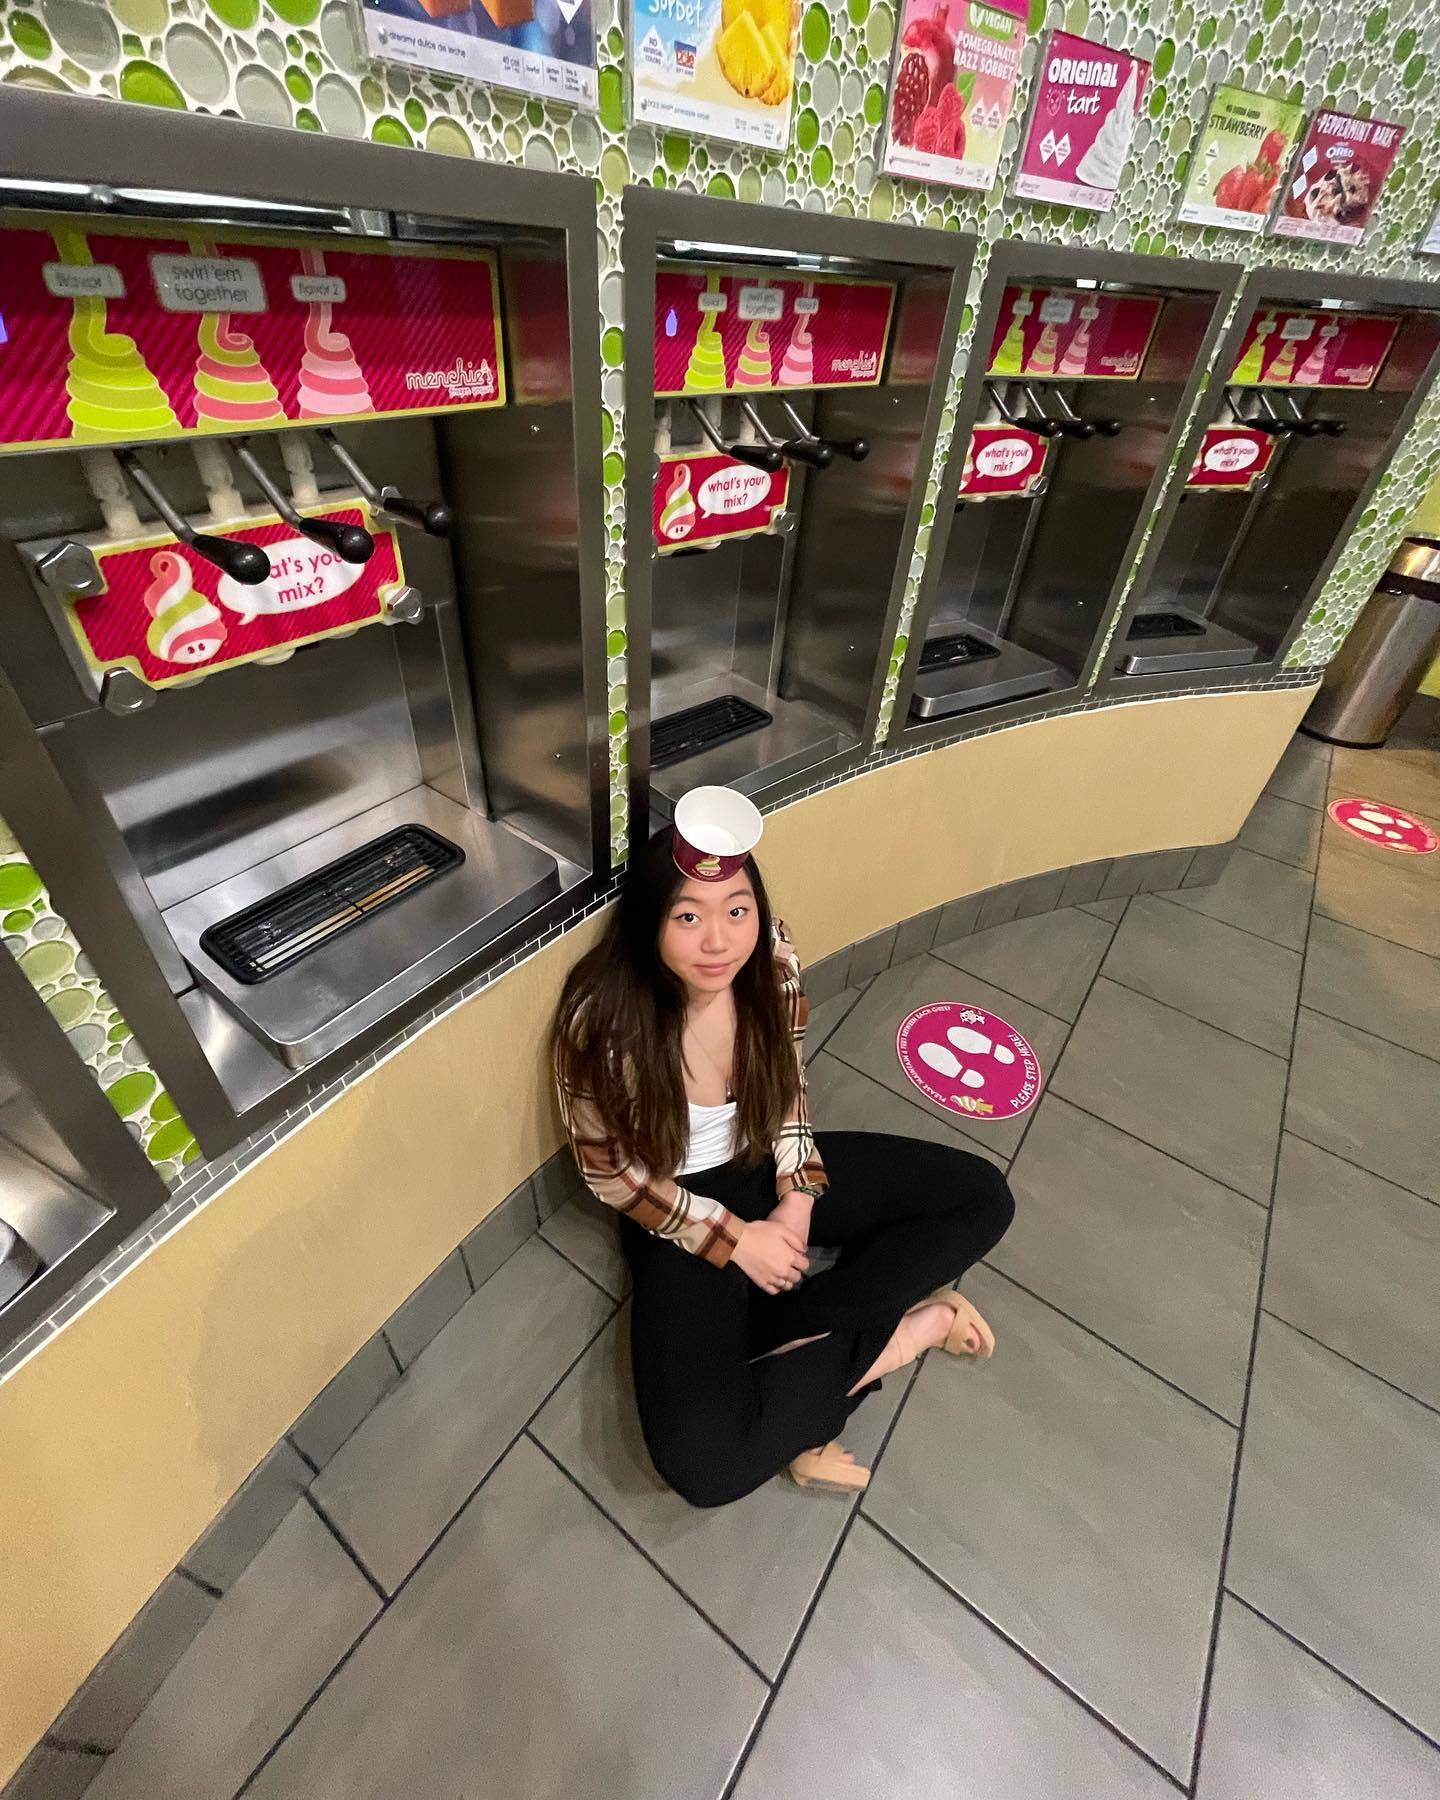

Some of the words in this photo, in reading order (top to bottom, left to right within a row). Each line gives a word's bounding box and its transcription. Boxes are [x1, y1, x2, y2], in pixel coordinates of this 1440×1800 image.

[984, 9, 1012, 33] VEGAN
[955, 31, 1017, 63] POMEGRANATE
[954, 48, 979, 70] RAZZ
[980, 58, 1015, 81] SORBET
[1067, 88, 1101, 115] tart
[1208, 114, 1267, 140] STRAWBERRY
[174, 284, 248, 304] together
[406, 357, 494, 390] menchie's
[985, 447, 1010, 458] what's
[994, 461, 1013, 471] mix?
[707, 477, 741, 493] what's
[744, 475, 765, 491] your
[723, 493, 748, 509] mix?
[270, 557, 303, 579] at's
[278, 576, 324, 604] mix?
[1008, 1033, 1031, 1057] HERE!
[1024, 1059, 1036, 1081] STEP
[922, 1084, 947, 1103] PLEASE
[1010, 1081, 1035, 1109] PLEASE
